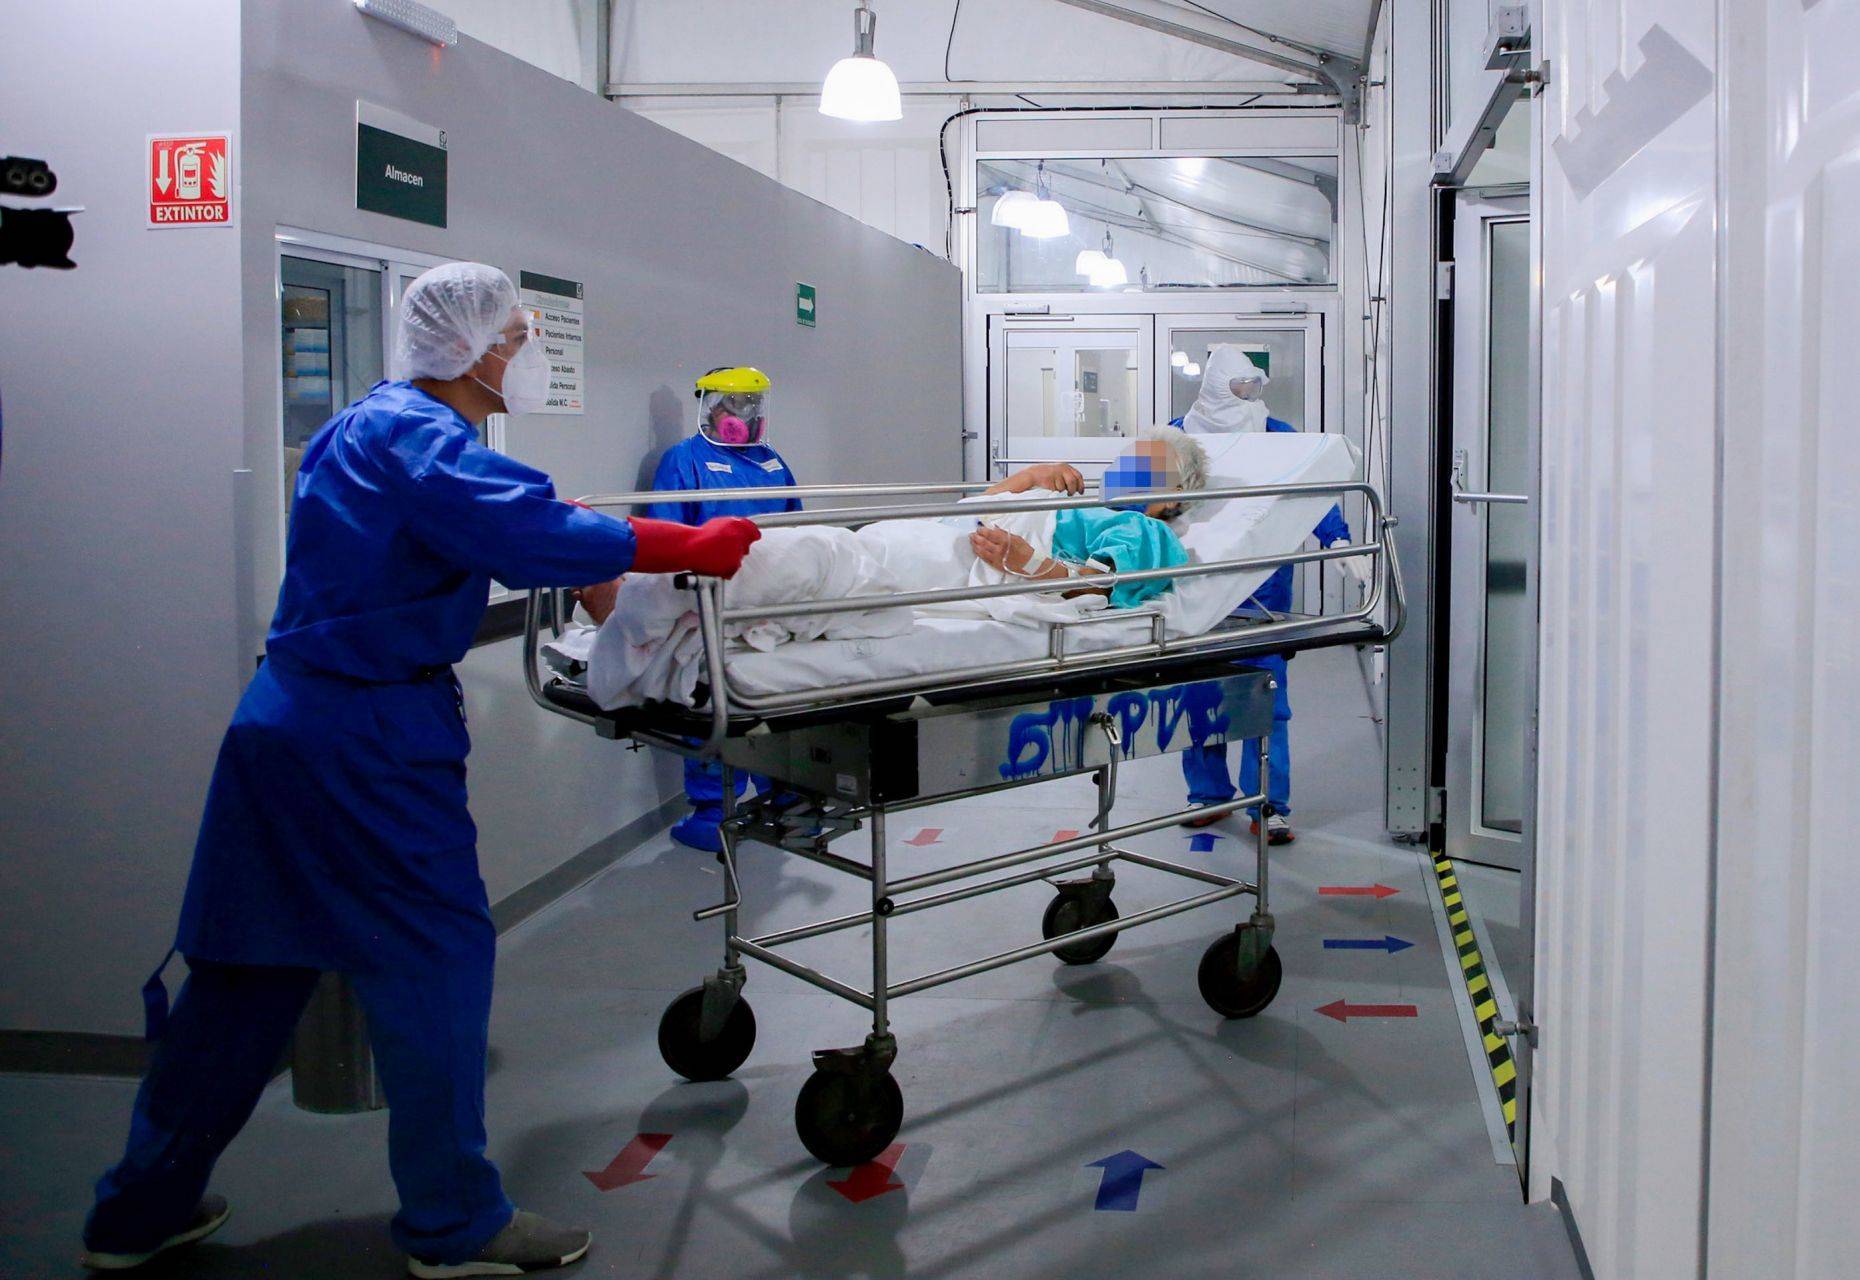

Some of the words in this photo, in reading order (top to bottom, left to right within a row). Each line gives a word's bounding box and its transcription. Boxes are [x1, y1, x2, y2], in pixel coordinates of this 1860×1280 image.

[385, 164, 423, 187] Almacen
[155, 205, 224, 222] EXTINTOR
[546, 346, 564, 356] Personal
[559, 382, 576, 390] Personal
